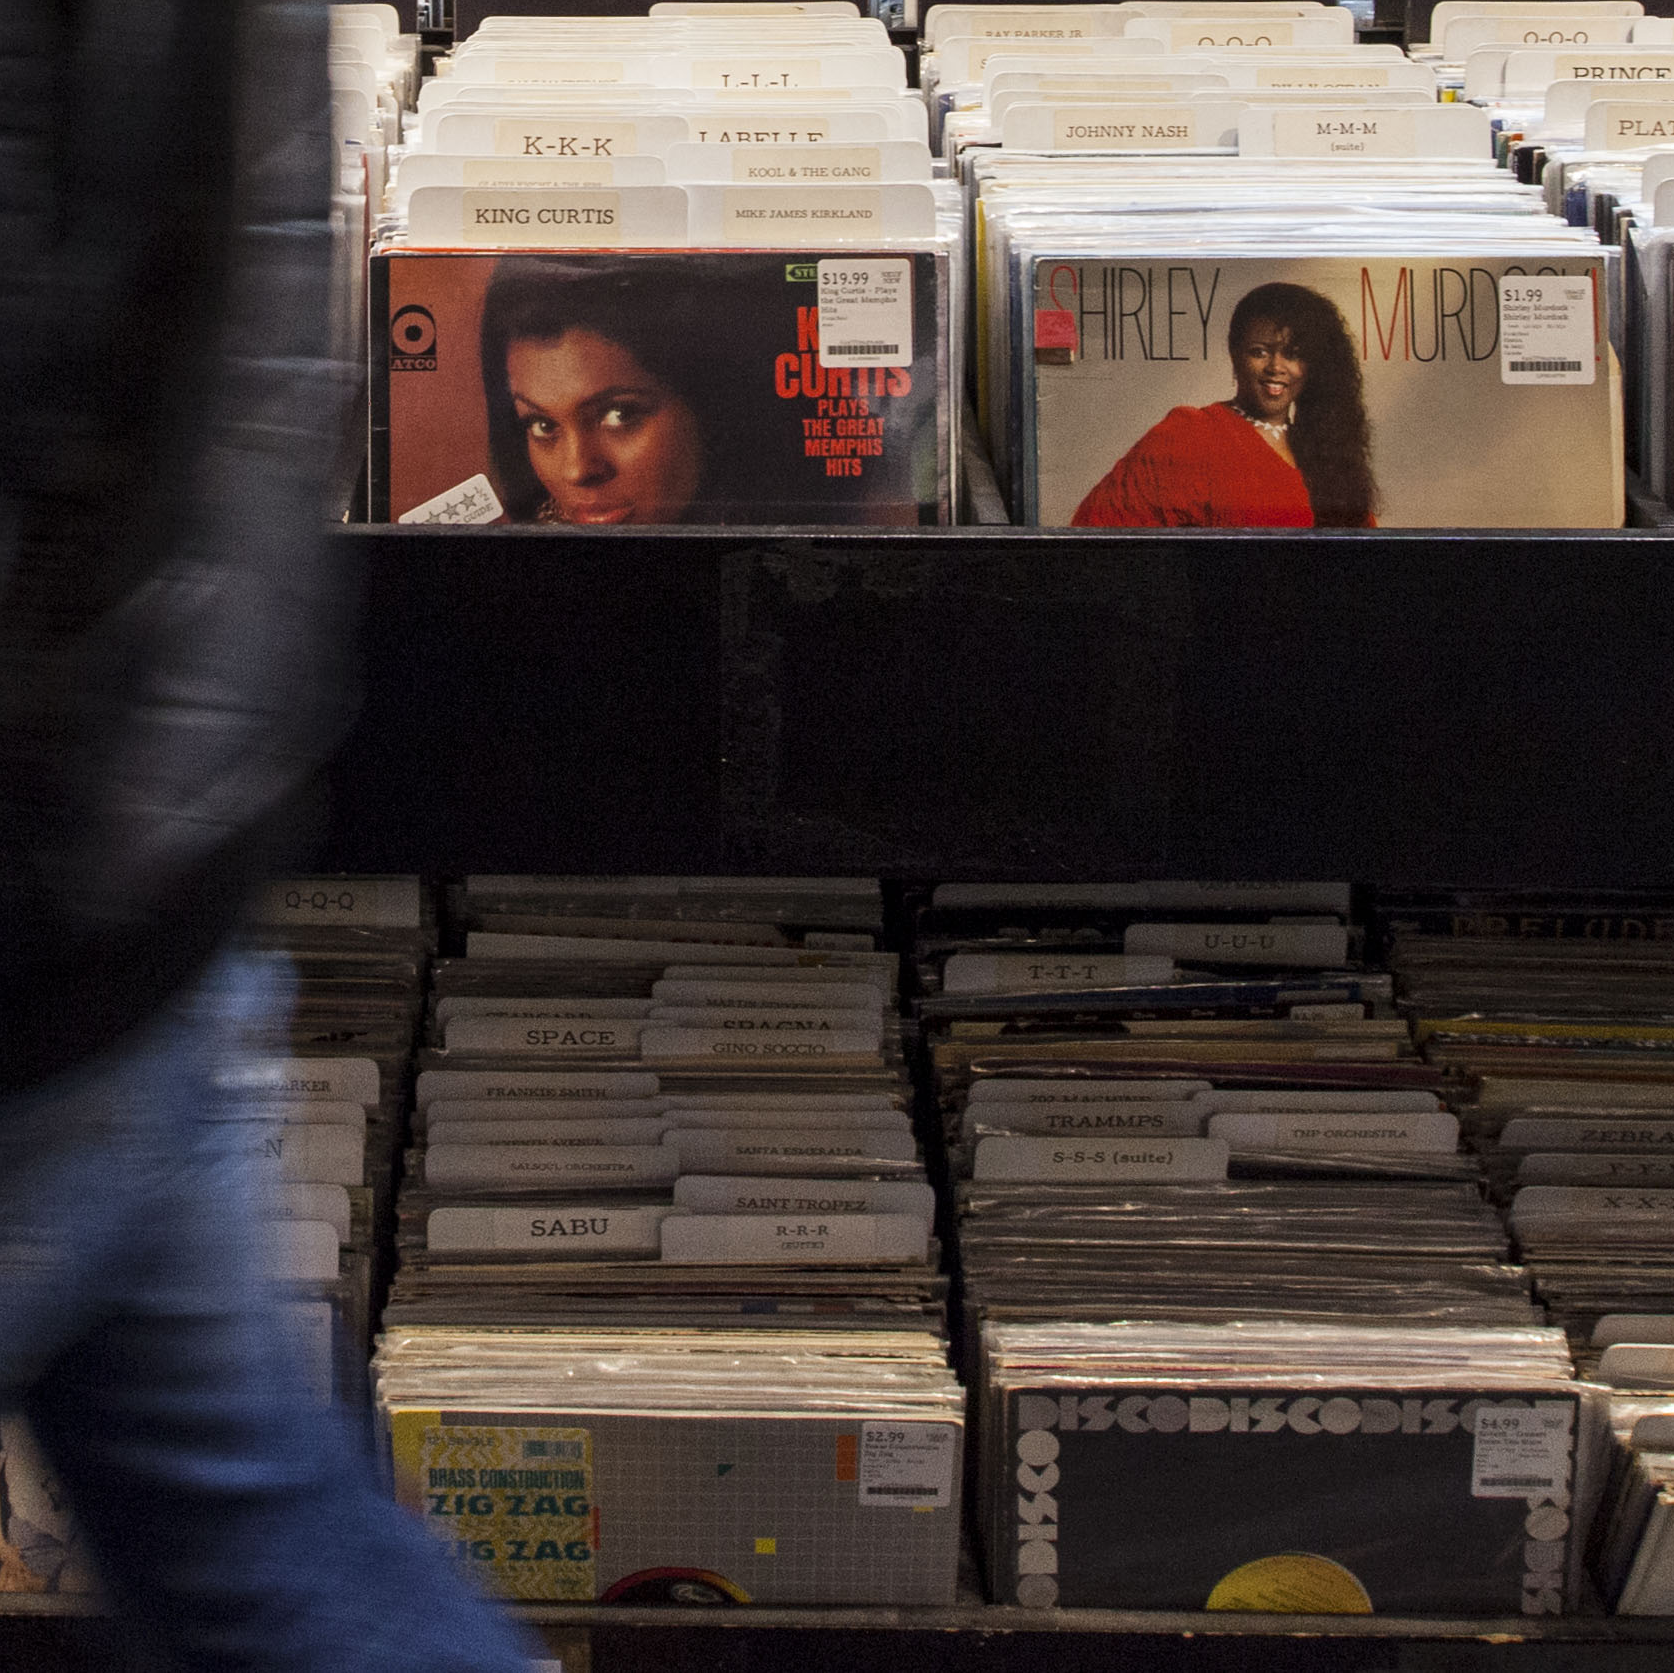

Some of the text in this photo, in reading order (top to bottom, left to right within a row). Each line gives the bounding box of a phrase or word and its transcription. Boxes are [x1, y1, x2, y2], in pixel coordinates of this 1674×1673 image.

[1066, 125, 1189, 139] JOHNNY NASH
[1316, 122, 1378, 136] M-M-M
[522, 135, 613, 156] K-K-K
[749, 166, 872, 177] KOOL & THE GANG
[475, 208, 615, 225] KING CURTIS
[822, 272, 869, 285] $19.99
[1504, 289, 1543, 302] $1.99
[392, 358, 437, 370] ATCO
[775, 353, 913, 399] CURTIS
[817, 400, 869, 416] PLAYS
[803, 419, 884, 436] THE GREAT
[805, 439, 883, 456] MEMPHIS
[826, 458, 863, 476] HITS
[526, 1030, 616, 1046] SPACE
[1045, 1114, 1165, 1127] TRAMMPS
[530, 1218, 610, 1236] SABU
[429, 1467, 586, 1490] BRASS CONSTRUCTION
[428, 1494, 590, 1517] ZIG ZAG
